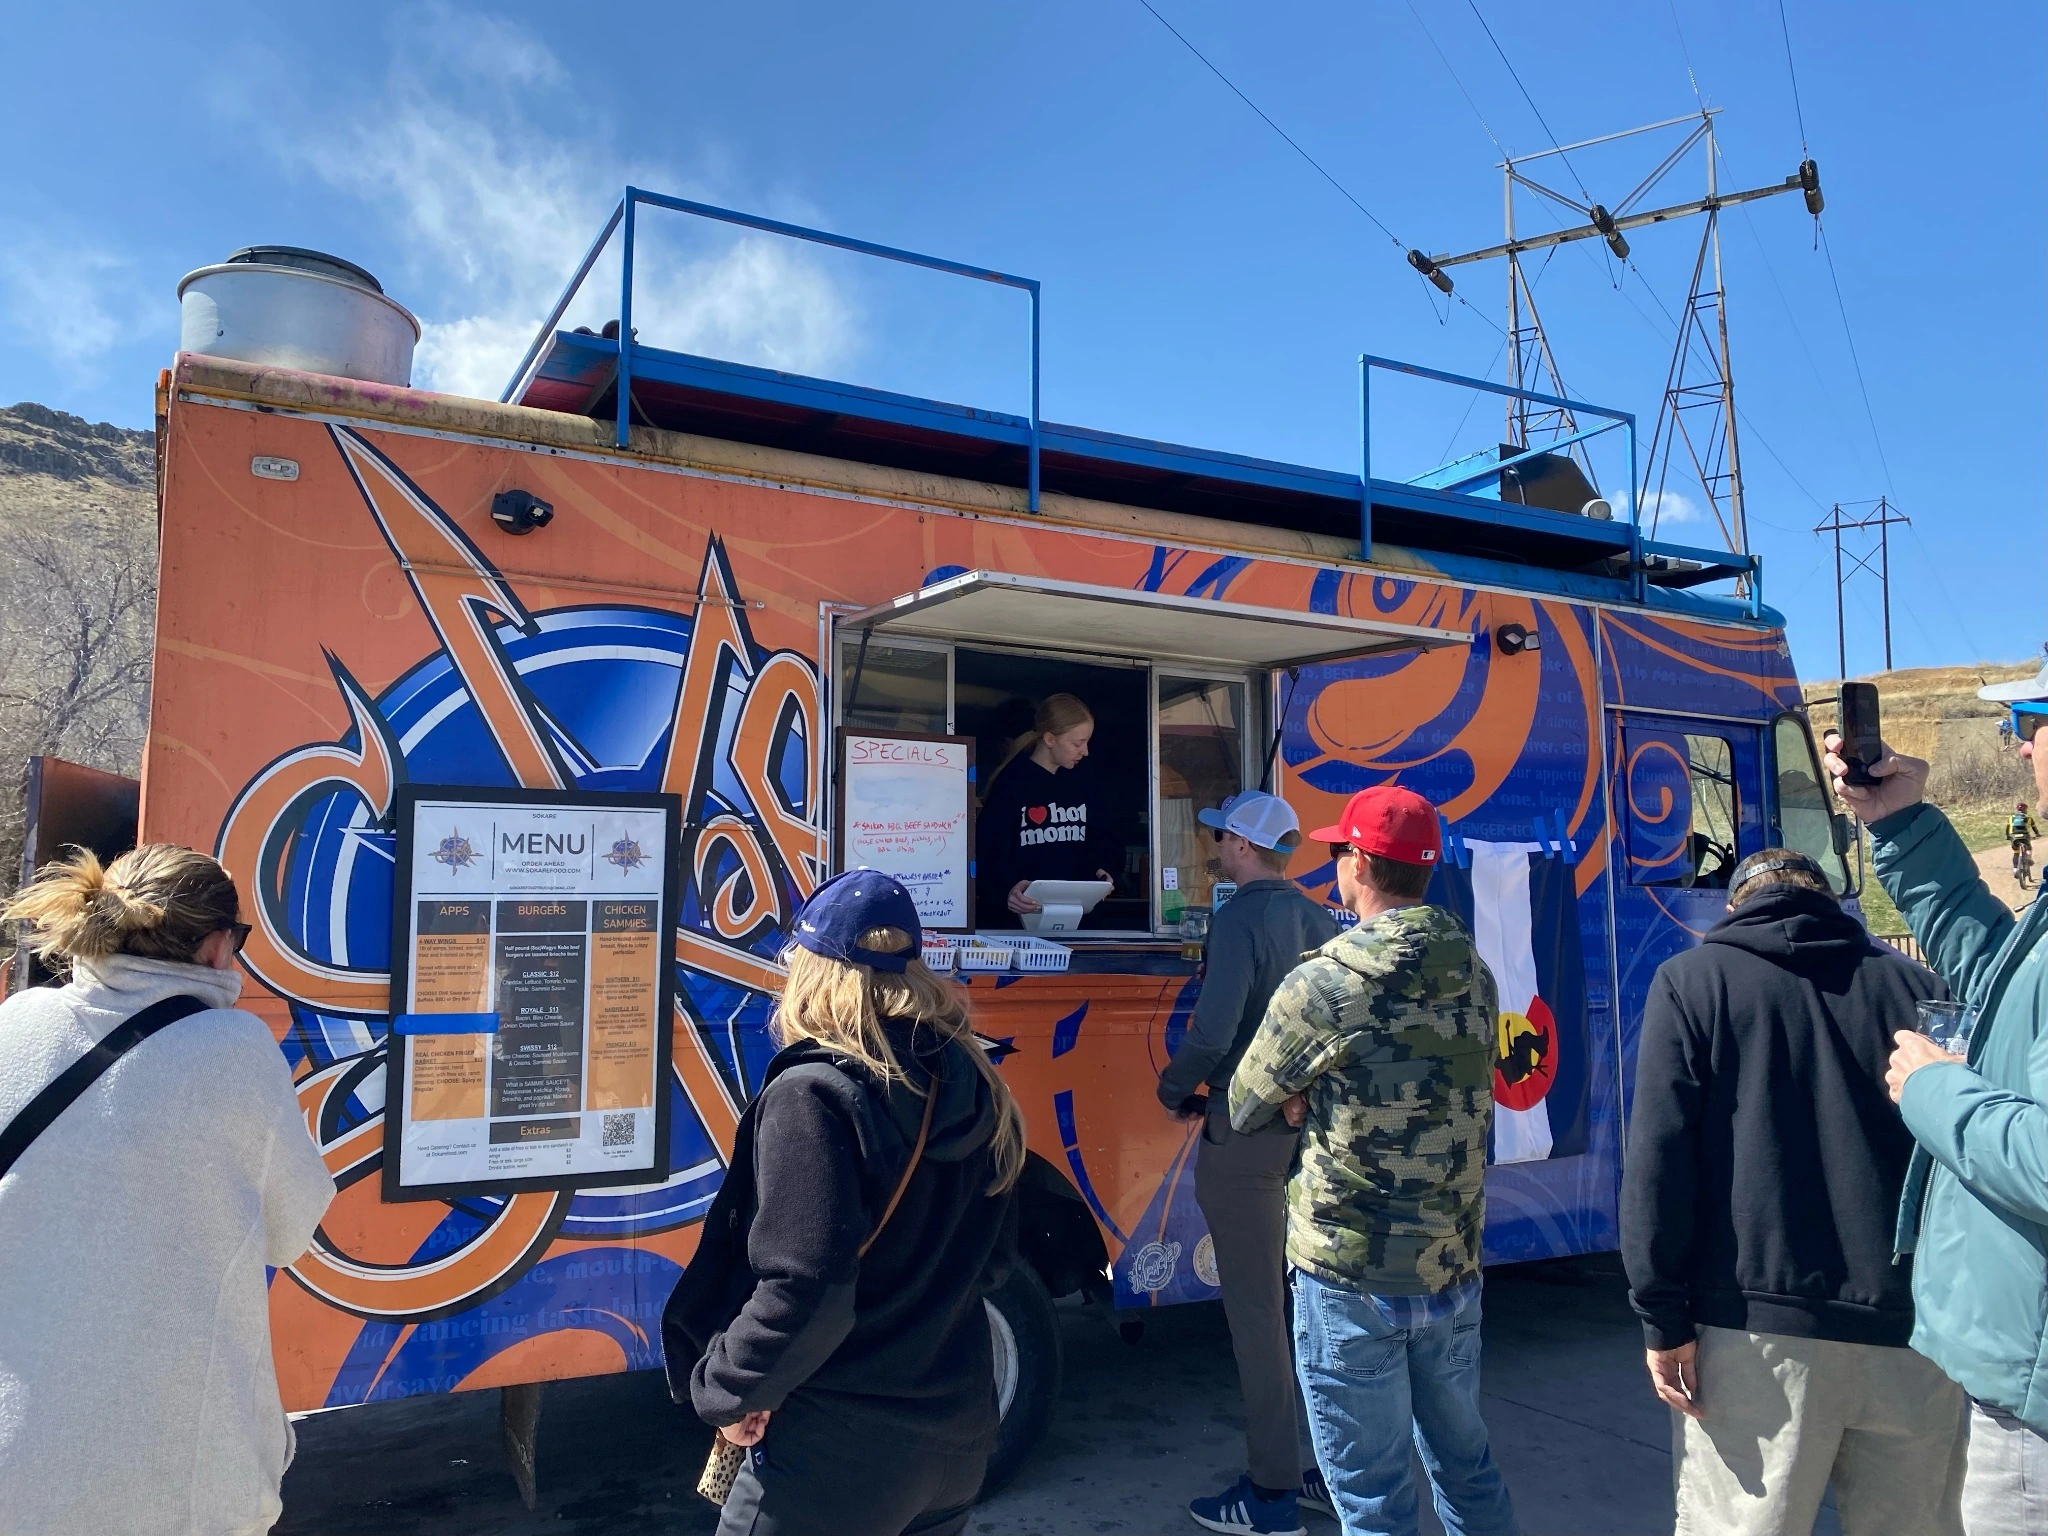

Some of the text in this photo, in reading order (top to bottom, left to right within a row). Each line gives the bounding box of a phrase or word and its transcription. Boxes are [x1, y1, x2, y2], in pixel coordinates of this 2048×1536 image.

[851, 741, 948, 764] SPECIALS
[1021, 802, 1086, 827] i hot
[905, 821, 921, 830] BEEF
[1020, 825, 1085, 846] moms
[502, 833, 585, 854] MENU
[440, 906, 469, 916] APPS
[518, 905, 566, 915] BURGERS
[605, 905, 646, 915] CHICKEN
[603, 919, 646, 928] SAMMIES
[521, 1126, 551, 1136] Extras
